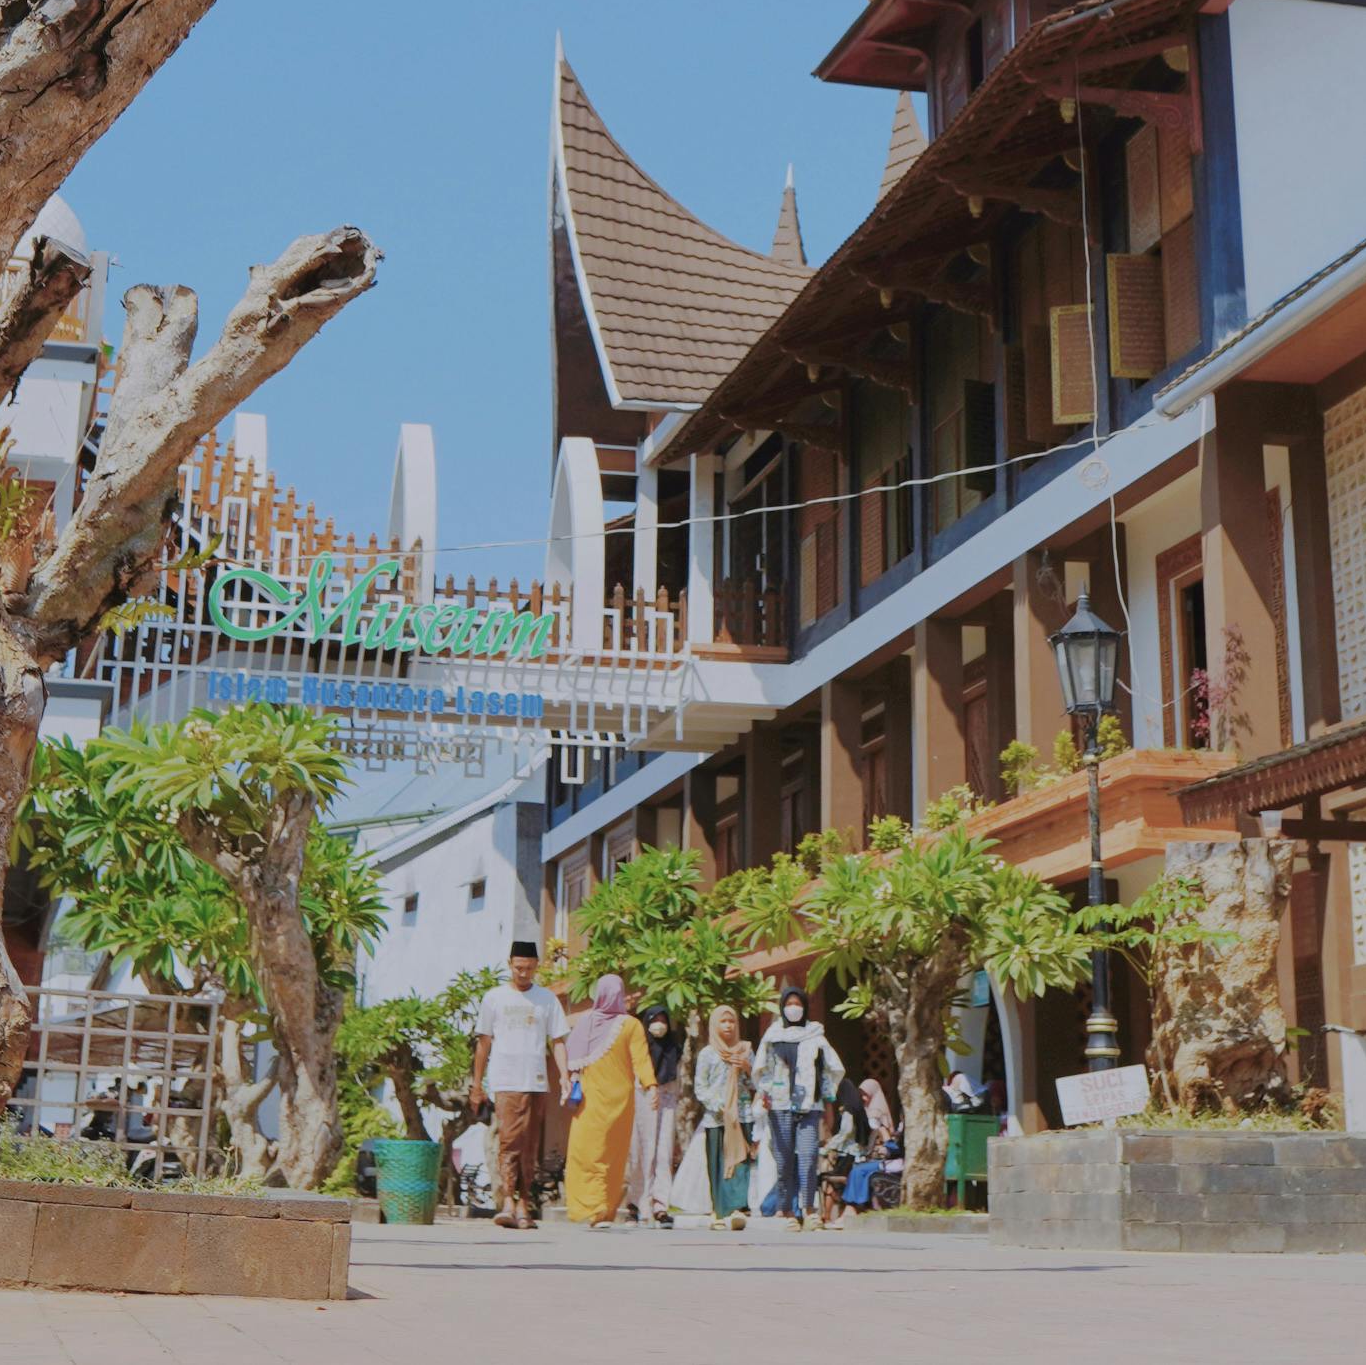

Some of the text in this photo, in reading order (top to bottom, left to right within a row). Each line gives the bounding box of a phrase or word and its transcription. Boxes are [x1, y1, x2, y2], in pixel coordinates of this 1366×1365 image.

[209, 551, 555, 657] Museum
[208, 670, 544, 718] Islam Nusantara Lasem
[1081, 1071, 1124, 1093] SUCI
